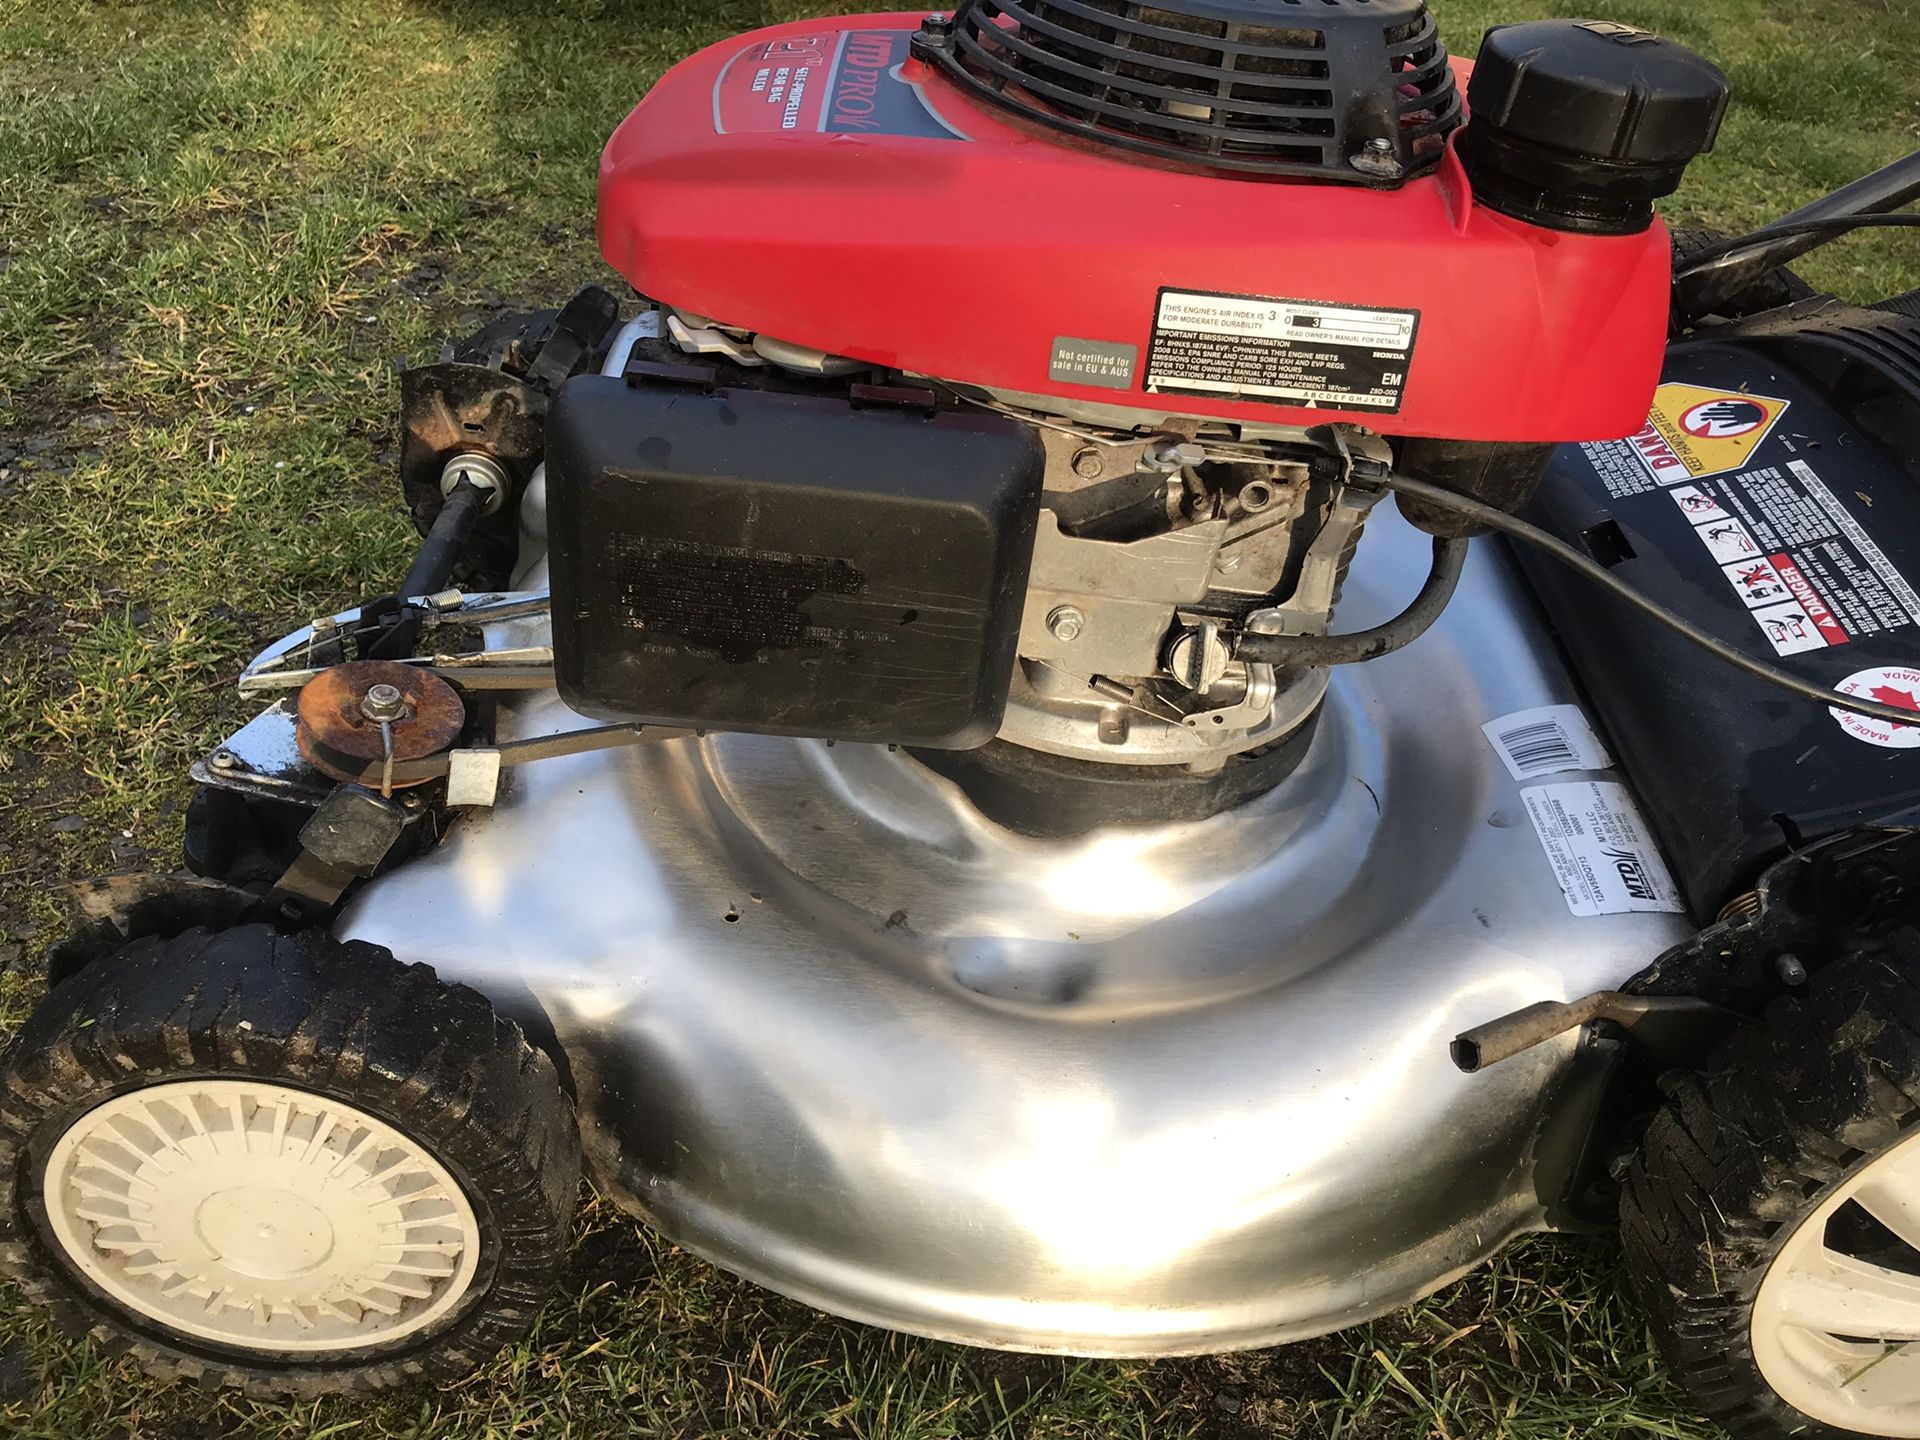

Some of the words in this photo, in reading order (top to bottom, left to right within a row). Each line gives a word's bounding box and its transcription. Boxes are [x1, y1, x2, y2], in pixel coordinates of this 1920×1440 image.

[846, 33, 893, 68] MTD
[752, 68, 771, 91] MULCH
[772, 67, 790, 86] REAR
[767, 86, 784, 103] BAG
[782, 67, 809, 128] SELF-PROPELLED
[1165, 304, 1182, 312] THIS
[1183, 306, 1217, 316] ENGINE'S
[1233, 311, 1255, 319] INDEX
[1268, 310, 1276, 321] 3
[1163, 314, 1178, 322] FOR
[1180, 316, 1218, 326] MODERATE
[1221, 319, 1263, 329] DURABILITY.
[1284, 315, 1292, 325] 0
[1312, 318, 1320, 327] 3
[1401, 326, 1411, 334] 10
[1156, 329, 1197, 339] IMPORTANT
[1199, 333, 1239, 343] EMISSIONS
[1241, 337, 1290, 347] INFORMATION
[1305, 331, 1333, 339] OWNER'S
[1335, 334, 1359, 342] MANUAL
[1058, 349, 1074, 360] Not
[1076, 353, 1114, 365] certified
[1117, 357, 1129, 367] for
[1153, 346, 1171, 354] 2008
[1238, 354, 1258, 362] CARB
[1271, 349, 1287, 357] THIS
[1288, 351, 1313, 359] ENGINE
[1315, 353, 1338, 361] MEETS
[1053, 361, 1071, 370] sale
[1074, 362, 1083, 371] in
[1085, 363, 1098, 373] EU
[1100, 365, 1107, 374] &
[1152, 354, 1189, 363] EMISSIONS
[1191, 357, 1234, 367] COMPLIANCE
[1236, 361, 1263, 369] PERIOD:
[1278, 365, 1302, 373] HOURS
[1150, 368, 1204, 379] SPECIFICATIONS
[1222, 375, 1271, 385] ADJUSTMENTS.
[1201, 365, 1232, 374] OWNER'S
[1234, 368, 1261, 377] MANUAL
[1278, 373, 1326, 382] MAINTENANCE
[1381, 373, 1401, 385] EM
[1635, 424, 1680, 470] DANG
[1667, 434, 1692, 456] HANDS
[1584, 448, 1598, 460] RISK
[1598, 451, 1618, 471] UNLESS
[1591, 459, 1604, 470] THE
[1611, 454, 1633, 477] CATCHER
[1683, 456, 1705, 472] KEEP
[1597, 469, 1617, 490] REDUCE
[1610, 471, 1633, 496] OPERATE
[1626, 476, 1644, 493] GRASS
[1611, 490, 1622, 499] TO
[1812, 562, 1828, 575] AWAY
[1781, 567, 1826, 615] DANGER
[1823, 576, 1839, 589] FEET
[1834, 589, 1847, 600] AND
[1843, 601, 1861, 619] HANDS
[1840, 618, 1858, 635] AVOID
[1856, 620, 1871, 633] KEEP
[1842, 715, 1855, 725] IN
[1852, 723, 1890, 741] MADE
[1585, 811, 1599, 826] LLC
[1593, 827, 1607, 843] MTD
[1617, 863, 1647, 899] MTD
